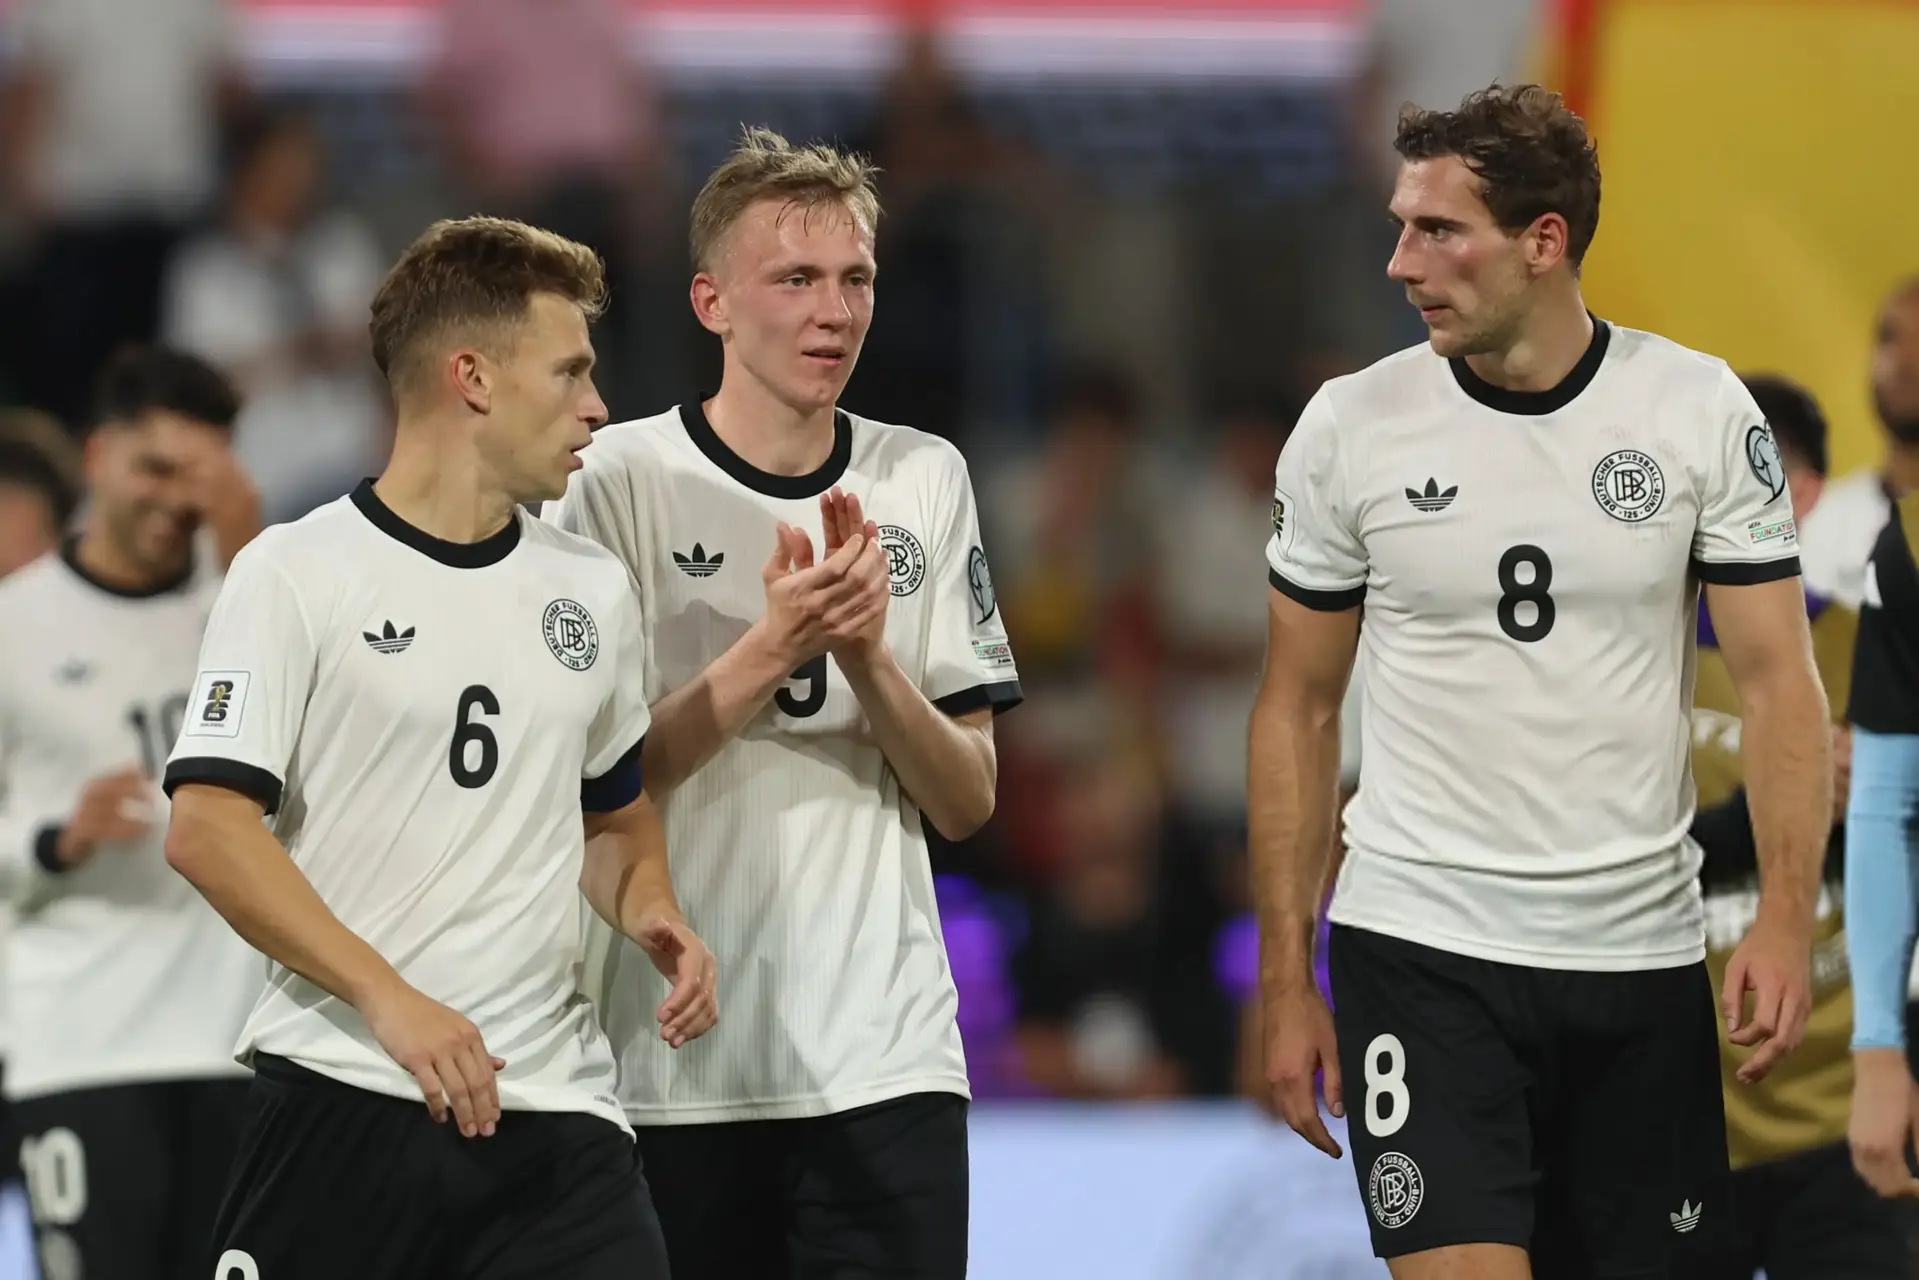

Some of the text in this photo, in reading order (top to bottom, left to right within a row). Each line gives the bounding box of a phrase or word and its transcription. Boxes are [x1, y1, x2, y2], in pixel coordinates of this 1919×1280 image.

[1596, 458, 1617, 512] DEUTSCHER
[1624, 510, 1639, 518] 125
[1750, 523, 1793, 540] FOUNDATIO
[1497, 544, 1555, 642] 8
[449, 684, 500, 788] 6
[1365, 1033, 1410, 1137] 8
[19, 1126, 88, 1226] 10
